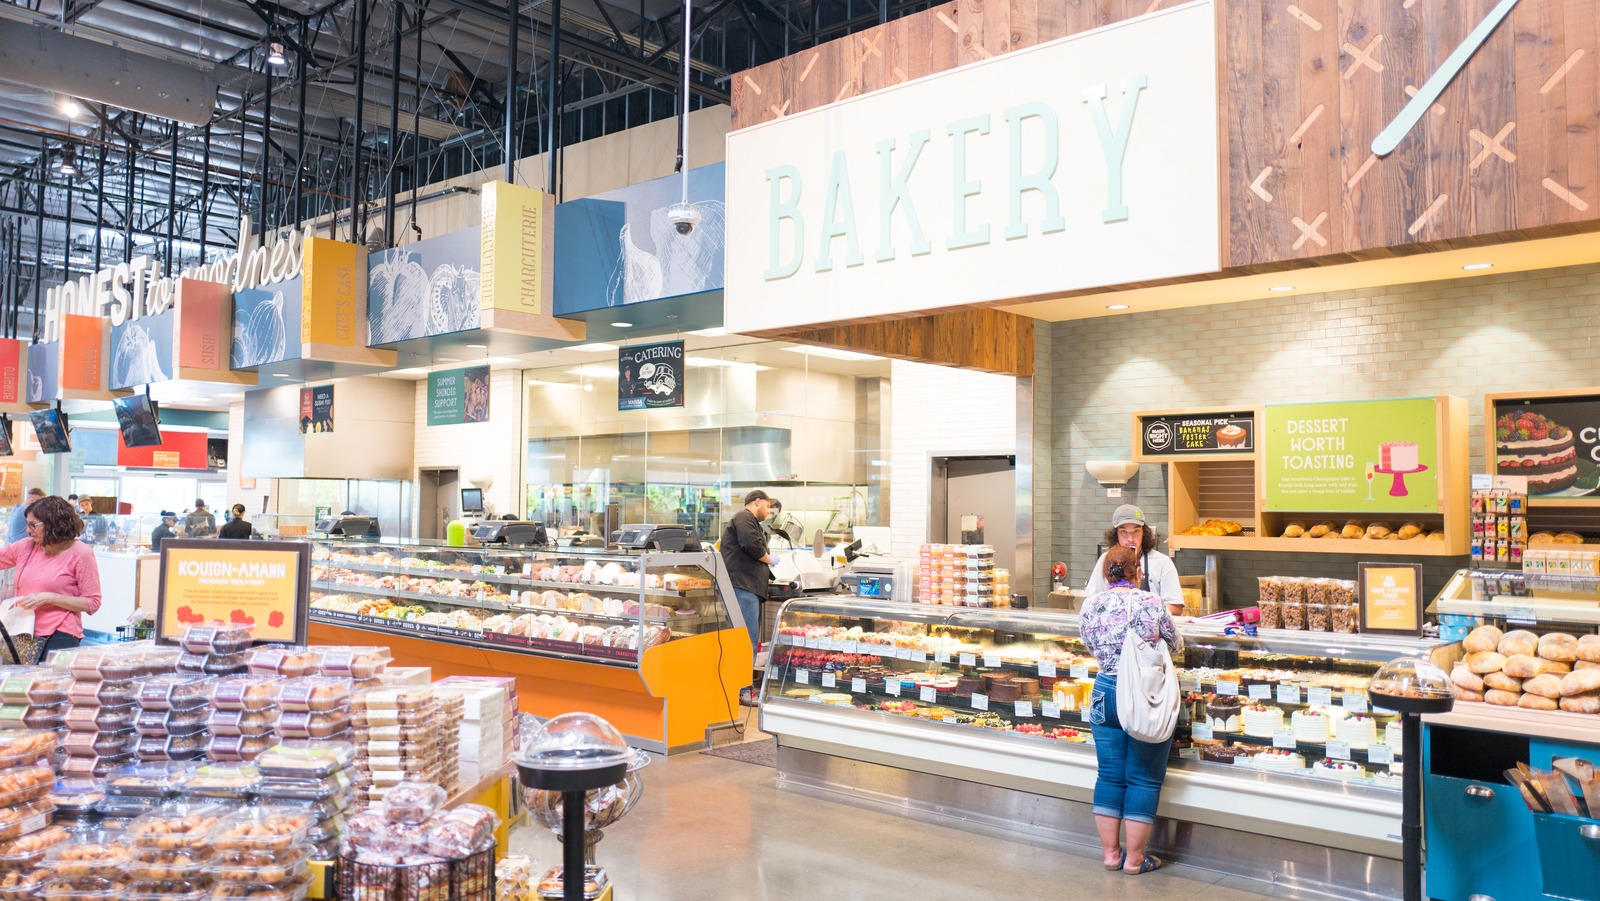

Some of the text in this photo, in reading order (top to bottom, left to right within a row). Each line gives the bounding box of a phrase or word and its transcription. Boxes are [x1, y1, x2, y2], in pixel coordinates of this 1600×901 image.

[764, 73, 1148, 281] BAKERY
[521, 205, 537, 307] CHARCUTERIE
[336, 265, 351, 297] CASE
[44, 254, 150, 345] HONEST
[146, 260, 173, 317] to
[202, 334, 216, 365] SUSHI
[634, 346, 682, 363] CATERING
[3, 366, 16, 400] BURRITO
[437, 376, 456, 386] SUMMER
[436, 387, 457, 397] SHINDIG
[434, 398, 458, 408] SUPPORT
[1287, 418, 1349, 434] DESSERT
[1580, 427, 1600, 443] C
[1290, 436, 1345, 452] WORTH
[1282, 454, 1354, 470] TOASTING
[178, 560, 287, 578] KOUIGN-AMANN
